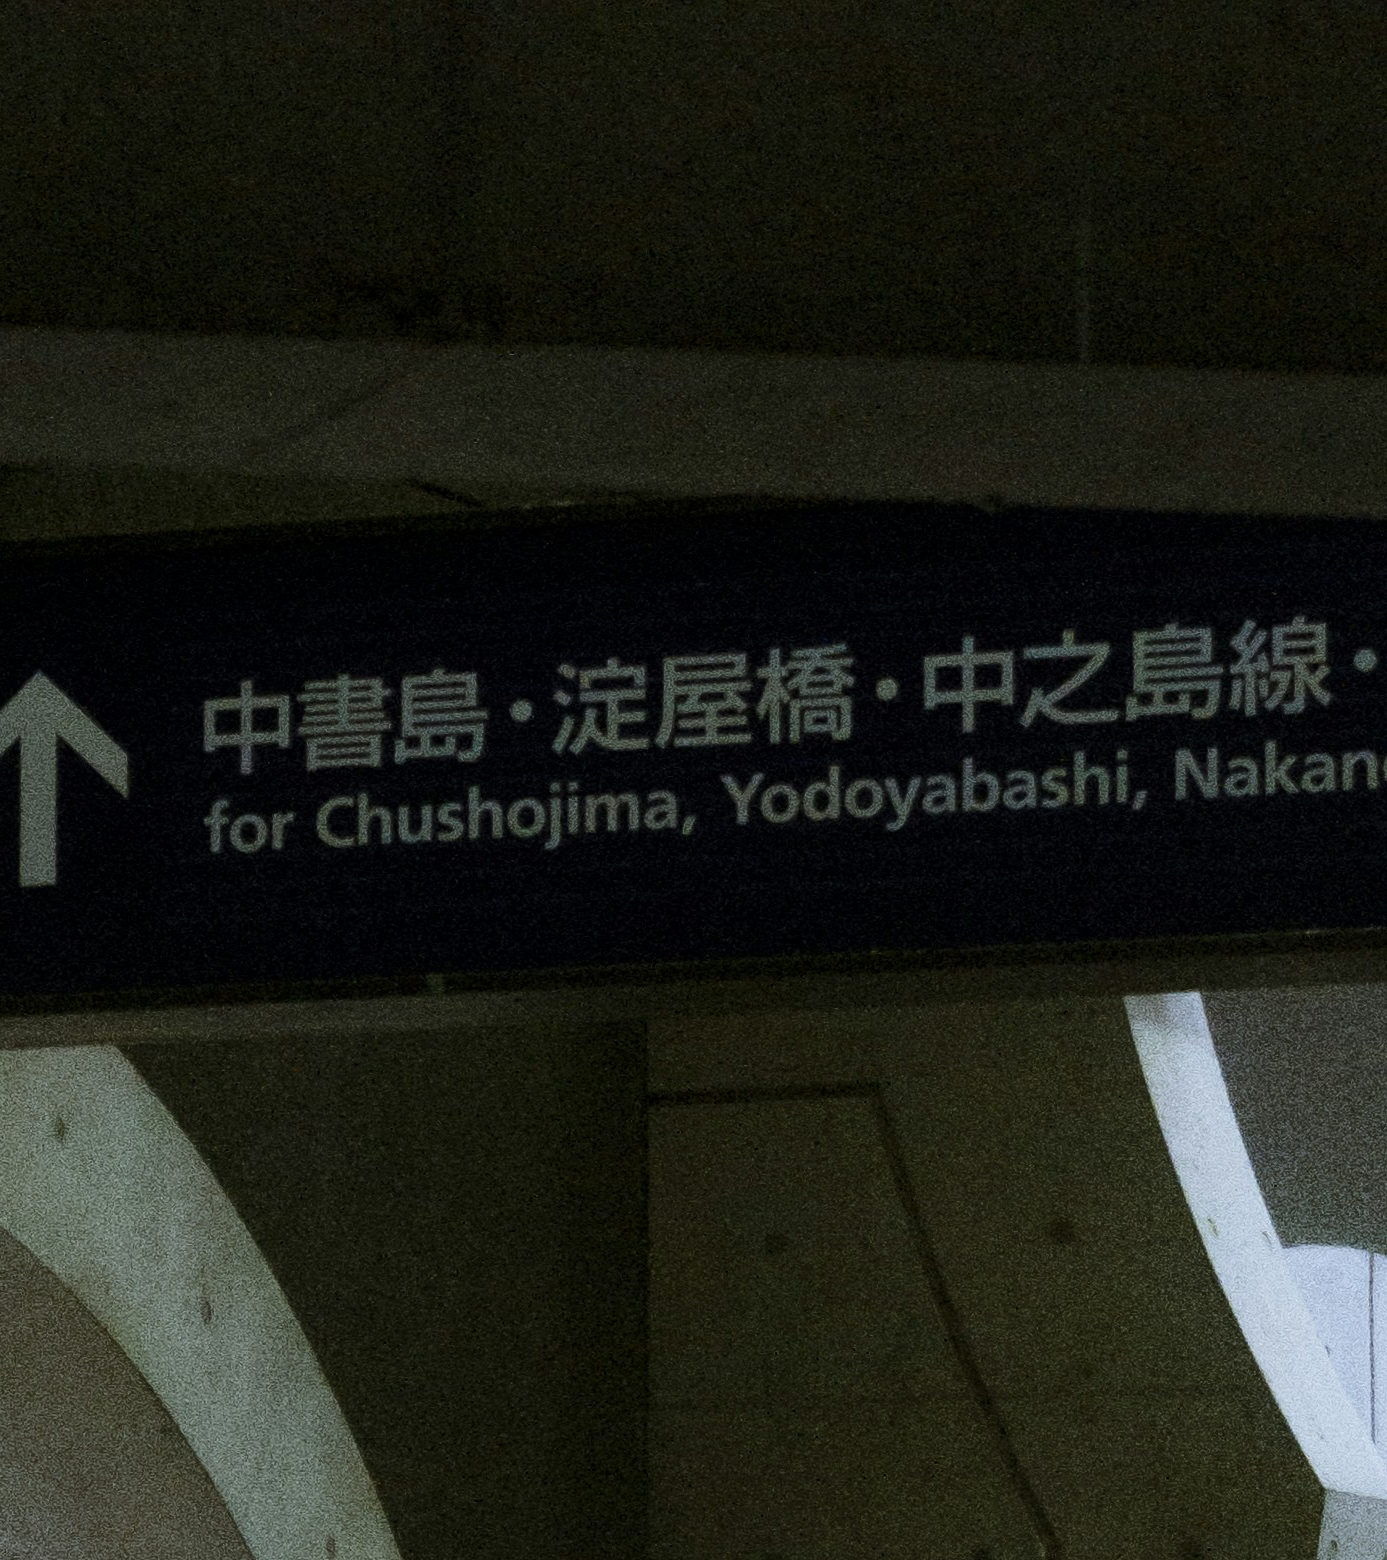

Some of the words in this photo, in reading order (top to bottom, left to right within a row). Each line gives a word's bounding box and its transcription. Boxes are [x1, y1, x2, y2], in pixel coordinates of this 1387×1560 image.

[203, 800, 296, 855] for
[316, 782, 697, 852] Chushojima,
[720, 747, 1148, 832] Yodoyabashi,
[1173, 739, 1387, 801] Nakan
